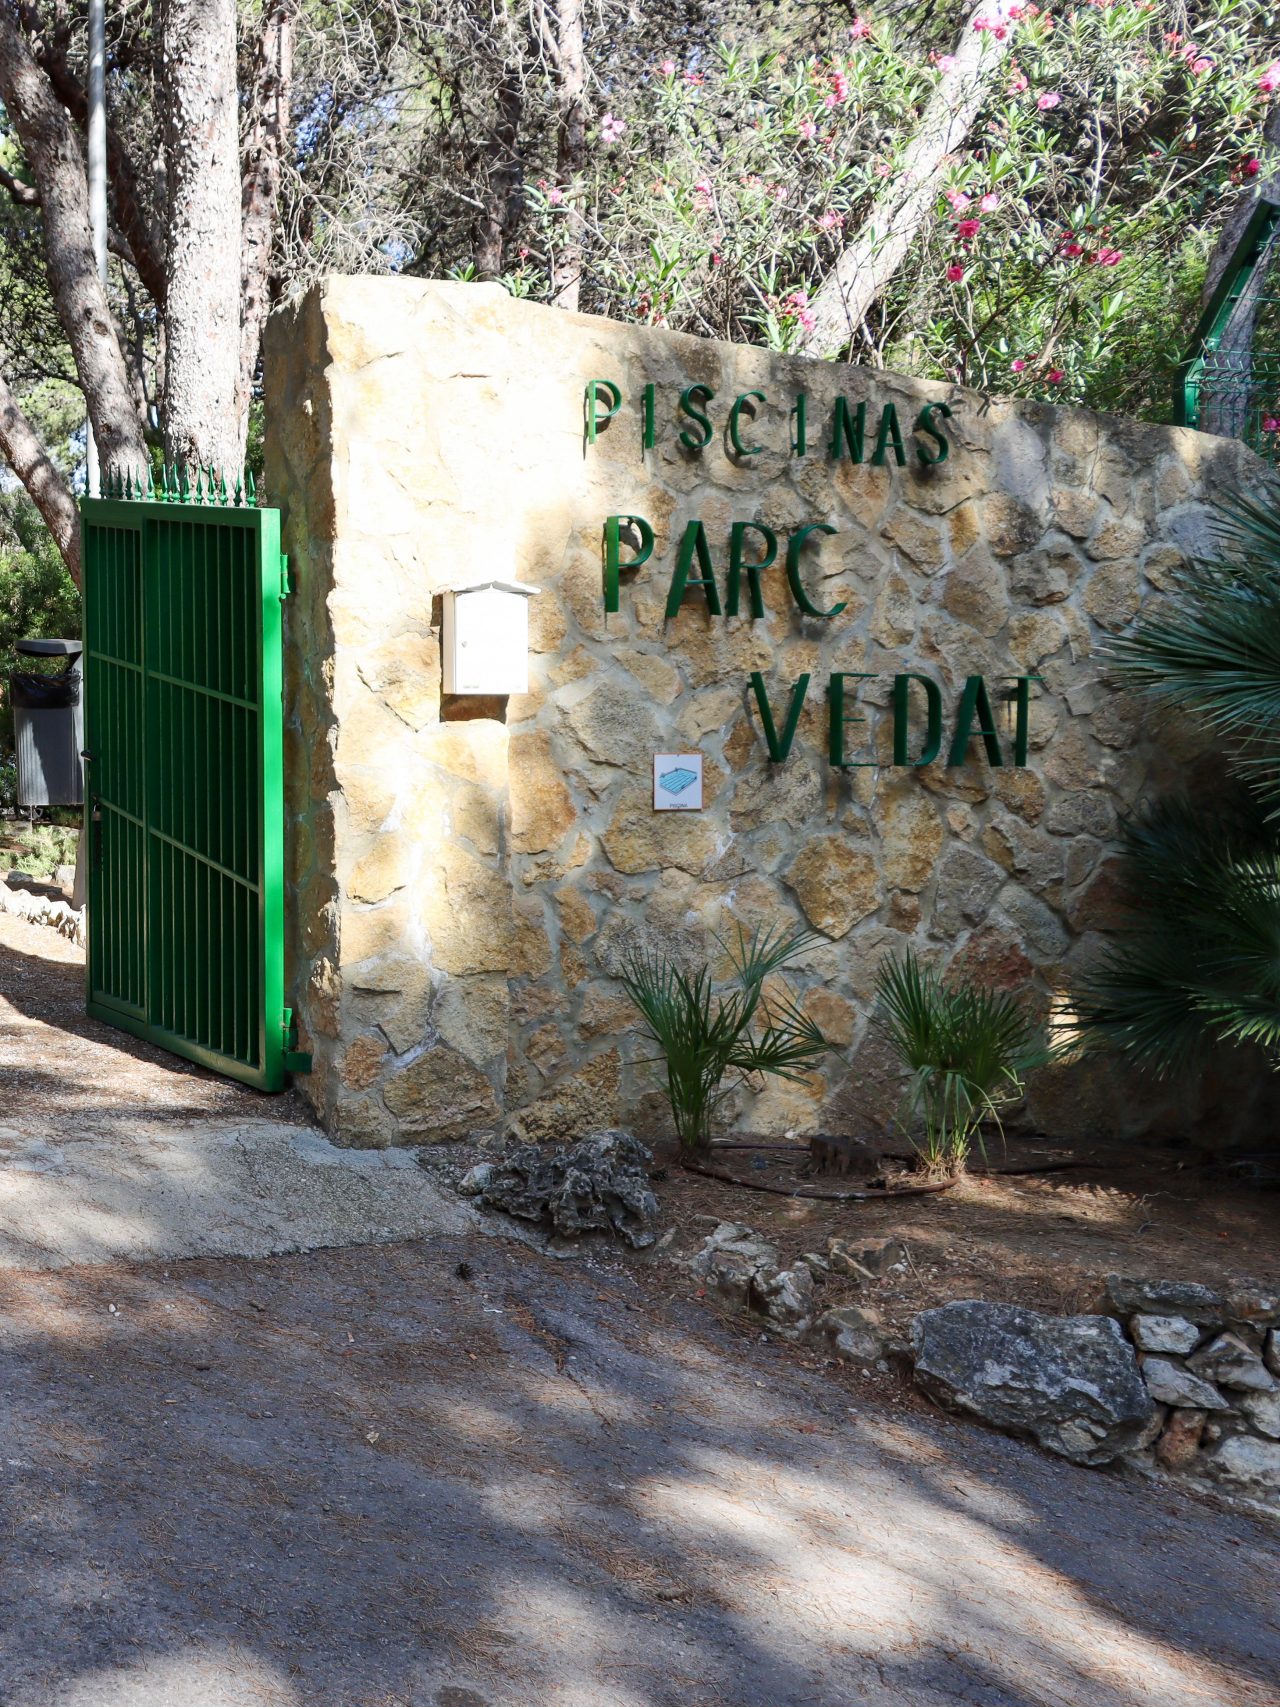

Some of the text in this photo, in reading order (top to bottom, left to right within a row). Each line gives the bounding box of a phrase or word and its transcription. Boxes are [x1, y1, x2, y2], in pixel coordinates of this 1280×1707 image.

[586, 379, 953, 467] PISCINAS
[603, 515, 848, 619] PARC
[747, 671, 1047, 767] VEDAT
